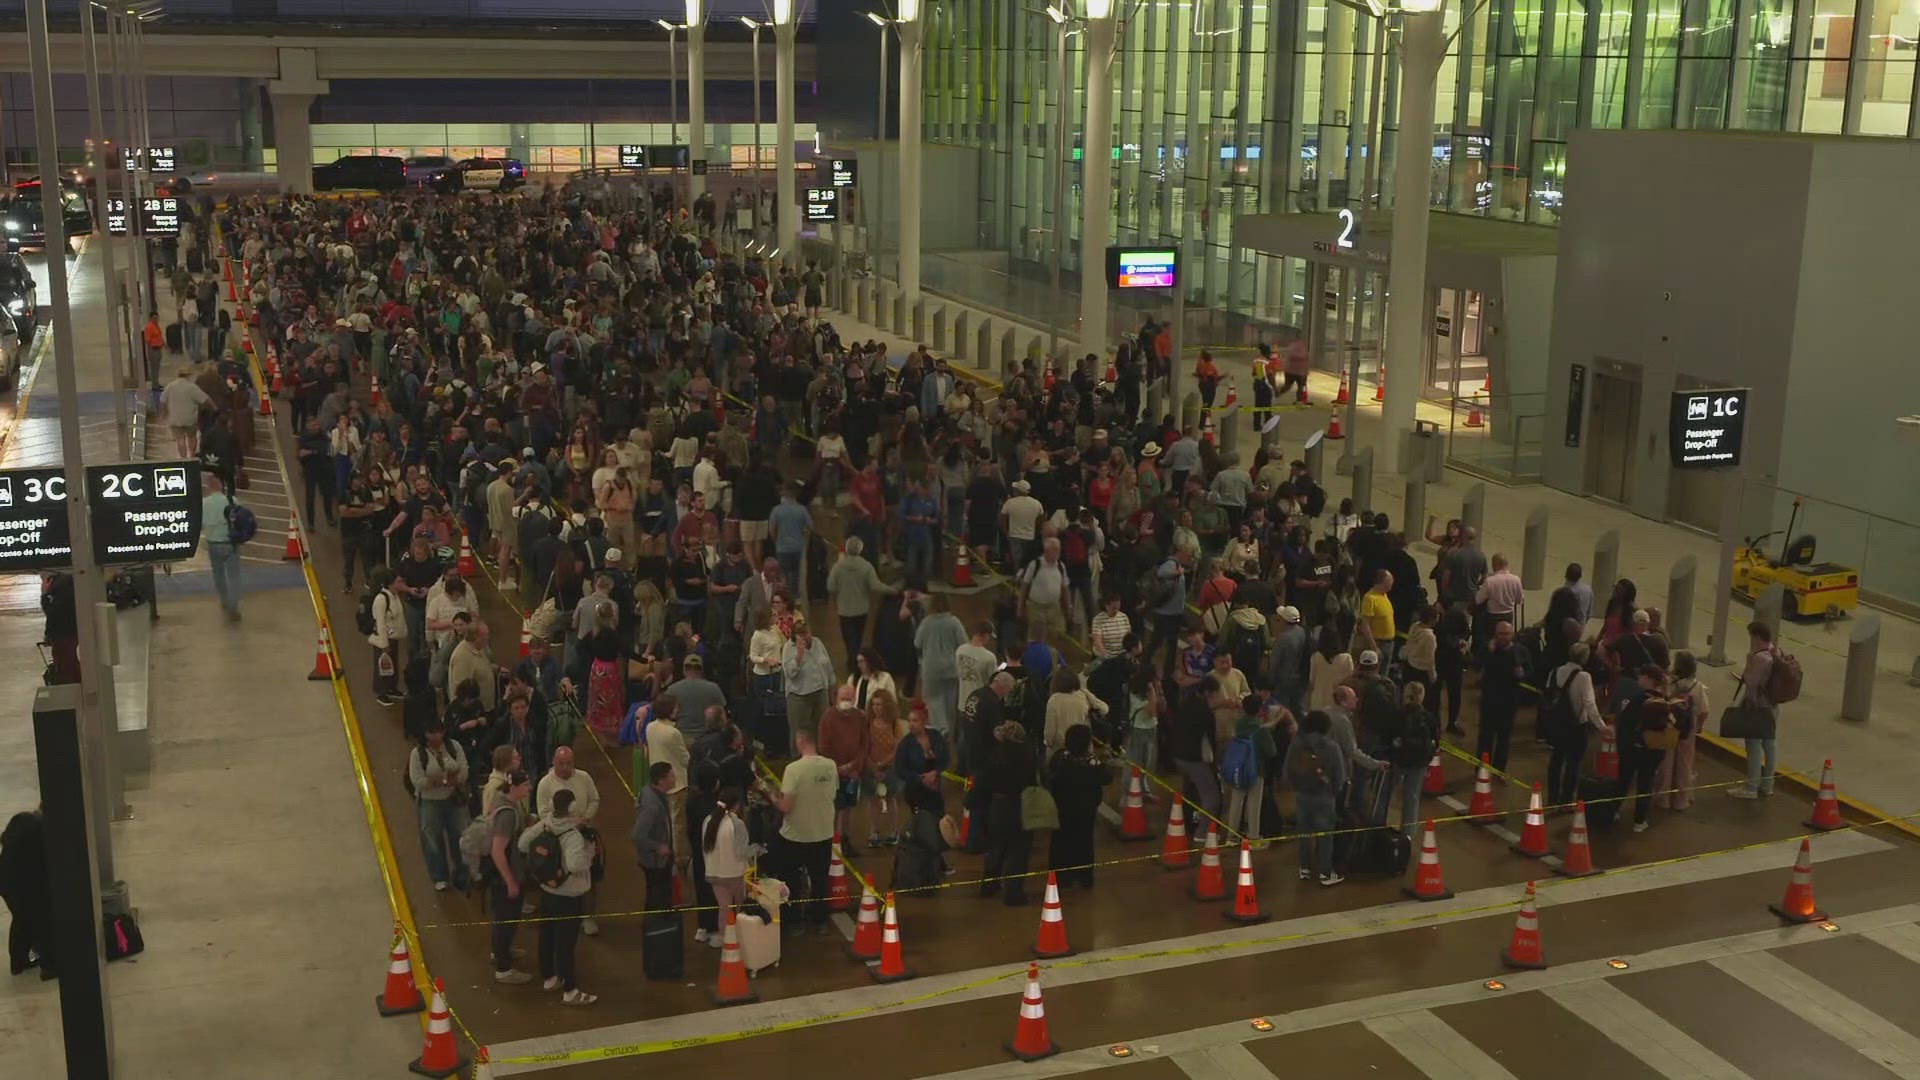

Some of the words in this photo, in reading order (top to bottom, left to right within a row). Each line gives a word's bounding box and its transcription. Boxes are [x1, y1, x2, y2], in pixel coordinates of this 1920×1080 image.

[150, 148, 163, 157] 2A
[631, 146, 643, 154] 1A
[821, 190, 835, 200] 1B
[144, 200, 161, 211] 2B
[1338, 209, 1353, 248] 2
[1713, 396, 1739, 417] 1C
[1685, 429, 1724, 439] Passenger
[1684, 438, 1718, 451] Drop-Off
[24, 477, 68, 503] 3C
[102, 472, 144, 498] 2C
[124, 509, 188, 523] Passenger
[135, 522, 189, 537] Drop-Off
[23, 548, 34, 557] de
[35, 546, 71, 556] Pasajeros
[107, 545, 144, 553] Descenso
[145, 543, 155, 552] de
[155, 541, 191, 551] Pasajeros
